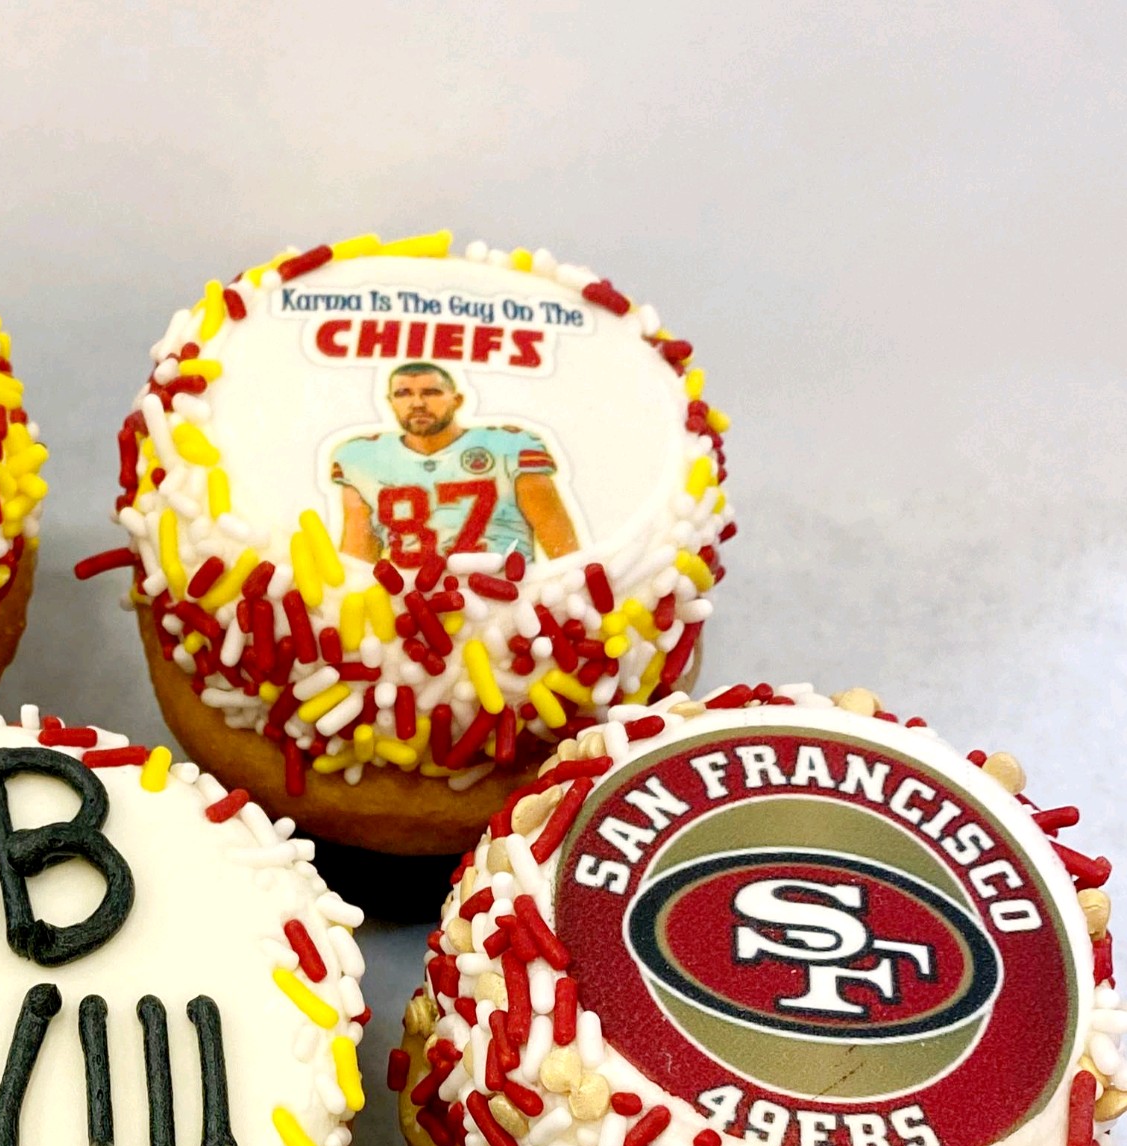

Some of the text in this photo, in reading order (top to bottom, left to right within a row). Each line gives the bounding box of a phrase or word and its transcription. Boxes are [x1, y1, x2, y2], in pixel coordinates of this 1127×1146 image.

[281, 288, 585, 327] Karma Is The Guy On The
[315, 318, 545, 368] CHIEFS
[377, 478, 499, 569] 87
[573, 743, 1043, 934] SAN FRANCISCO
[732, 876, 937, 1018] SF
